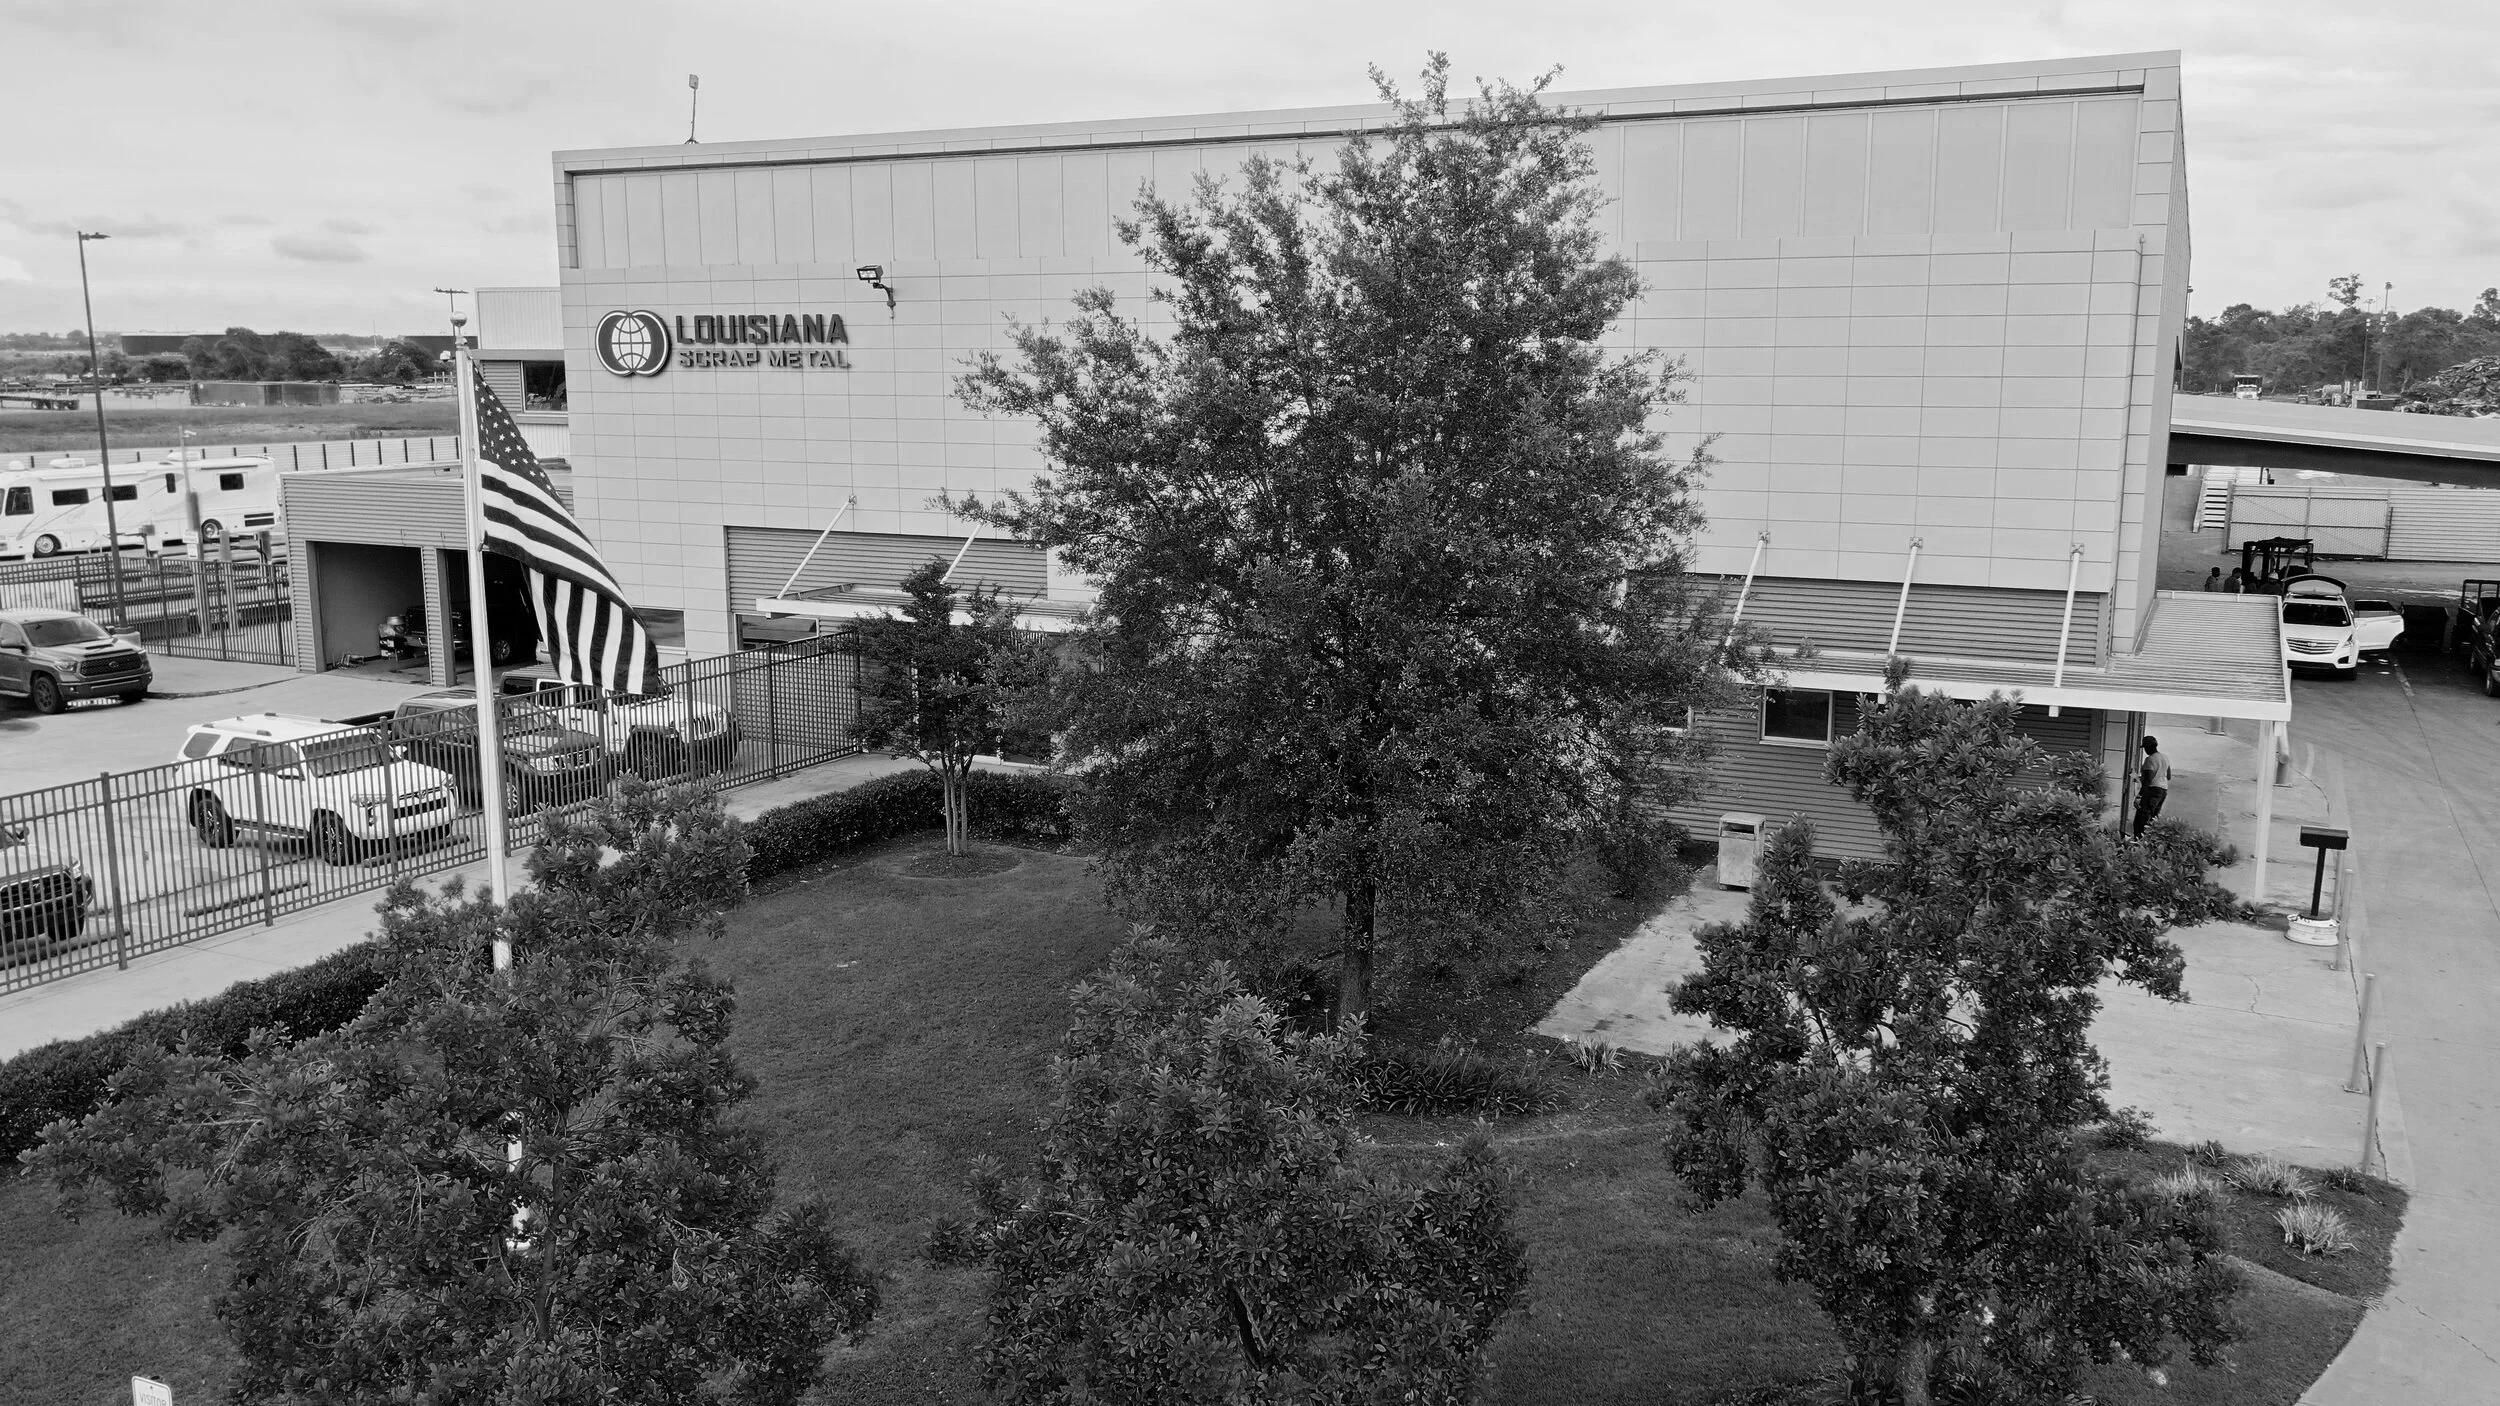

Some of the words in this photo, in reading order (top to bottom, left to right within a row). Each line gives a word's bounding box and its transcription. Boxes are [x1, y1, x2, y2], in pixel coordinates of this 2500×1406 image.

[676, 314, 848, 344] LOUISIANA
[680, 350, 760, 368] SCRAP
[769, 350, 850, 368] METAL
[139, 1391, 168, 1406] VISITOR
